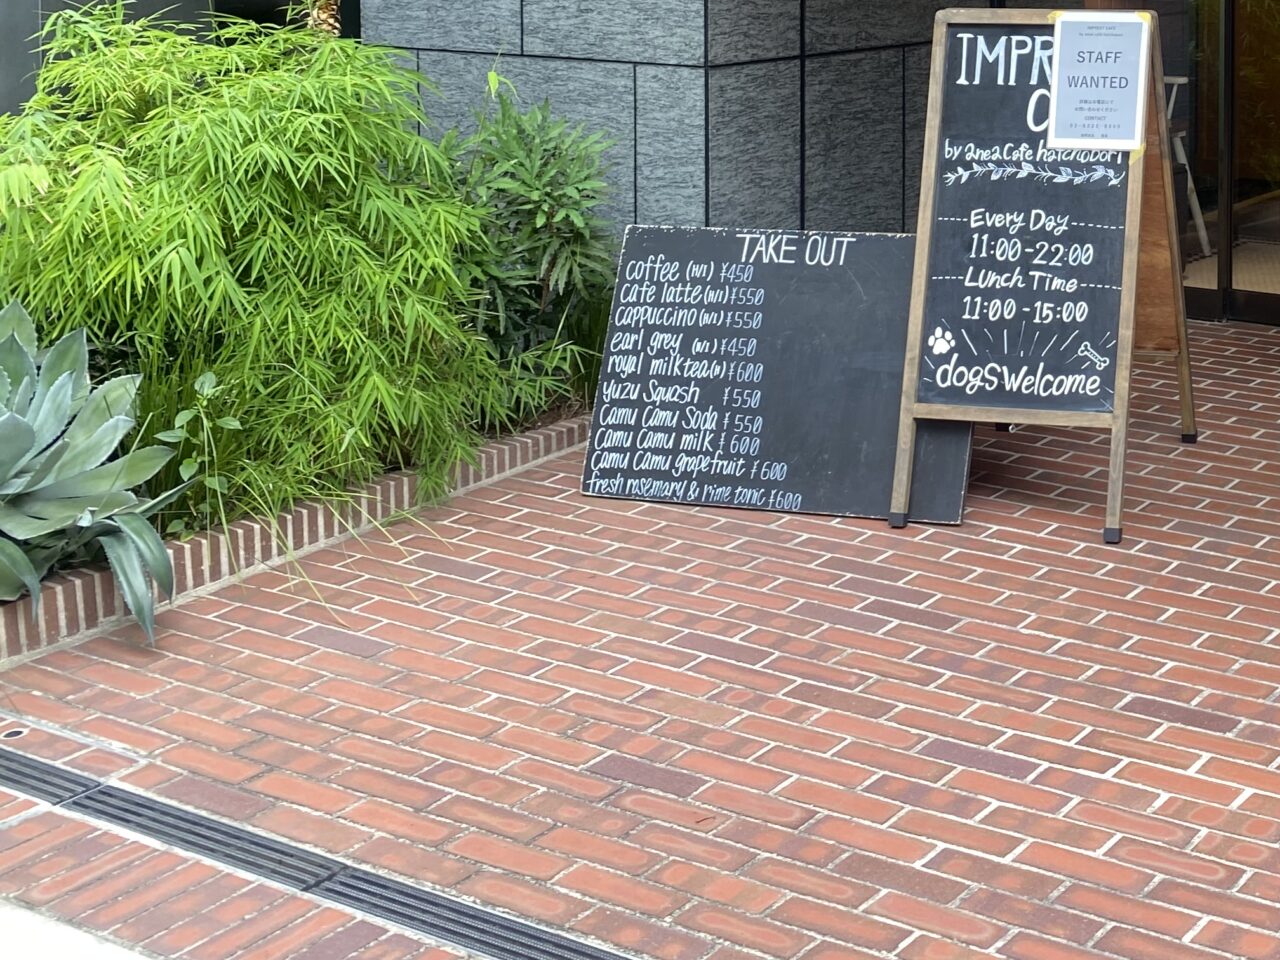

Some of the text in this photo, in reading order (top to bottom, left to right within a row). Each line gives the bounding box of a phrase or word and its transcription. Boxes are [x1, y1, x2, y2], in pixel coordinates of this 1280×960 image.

[955, 32, 1055, 86] IMPR
[1076, 50, 1123, 64] STAFF
[1067, 75, 1129, 89] WANTED
[944, 138, 962, 160] by
[969, 207, 1070, 236] Every Day
[735, 233, 857, 266] TAKE OUT
[625, 253, 680, 282] coffee
[720, 261, 754, 283] ¥450
[964, 266, 1078, 292] Lunch Time
[620, 281, 655, 304] cafe
[660, 282, 702, 304] latte
[614, 305, 698, 328] cappuccino
[610, 328, 644, 352] earl
[647, 331, 683, 355] grey
[720, 337, 757, 357] ¥450
[607, 352, 644, 378] royal
[727, 361, 764, 383] ¥600
[602, 379, 641, 404] yuzu
[642, 379, 700, 406] Squash
[682, 405, 718, 431] Soda
[680, 429, 714, 452] milk
[671, 450, 746, 478] grapefruit
[586, 471, 624, 495] fresh
[687, 481, 700, 501] &
[733, 486, 767, 506] tonic
